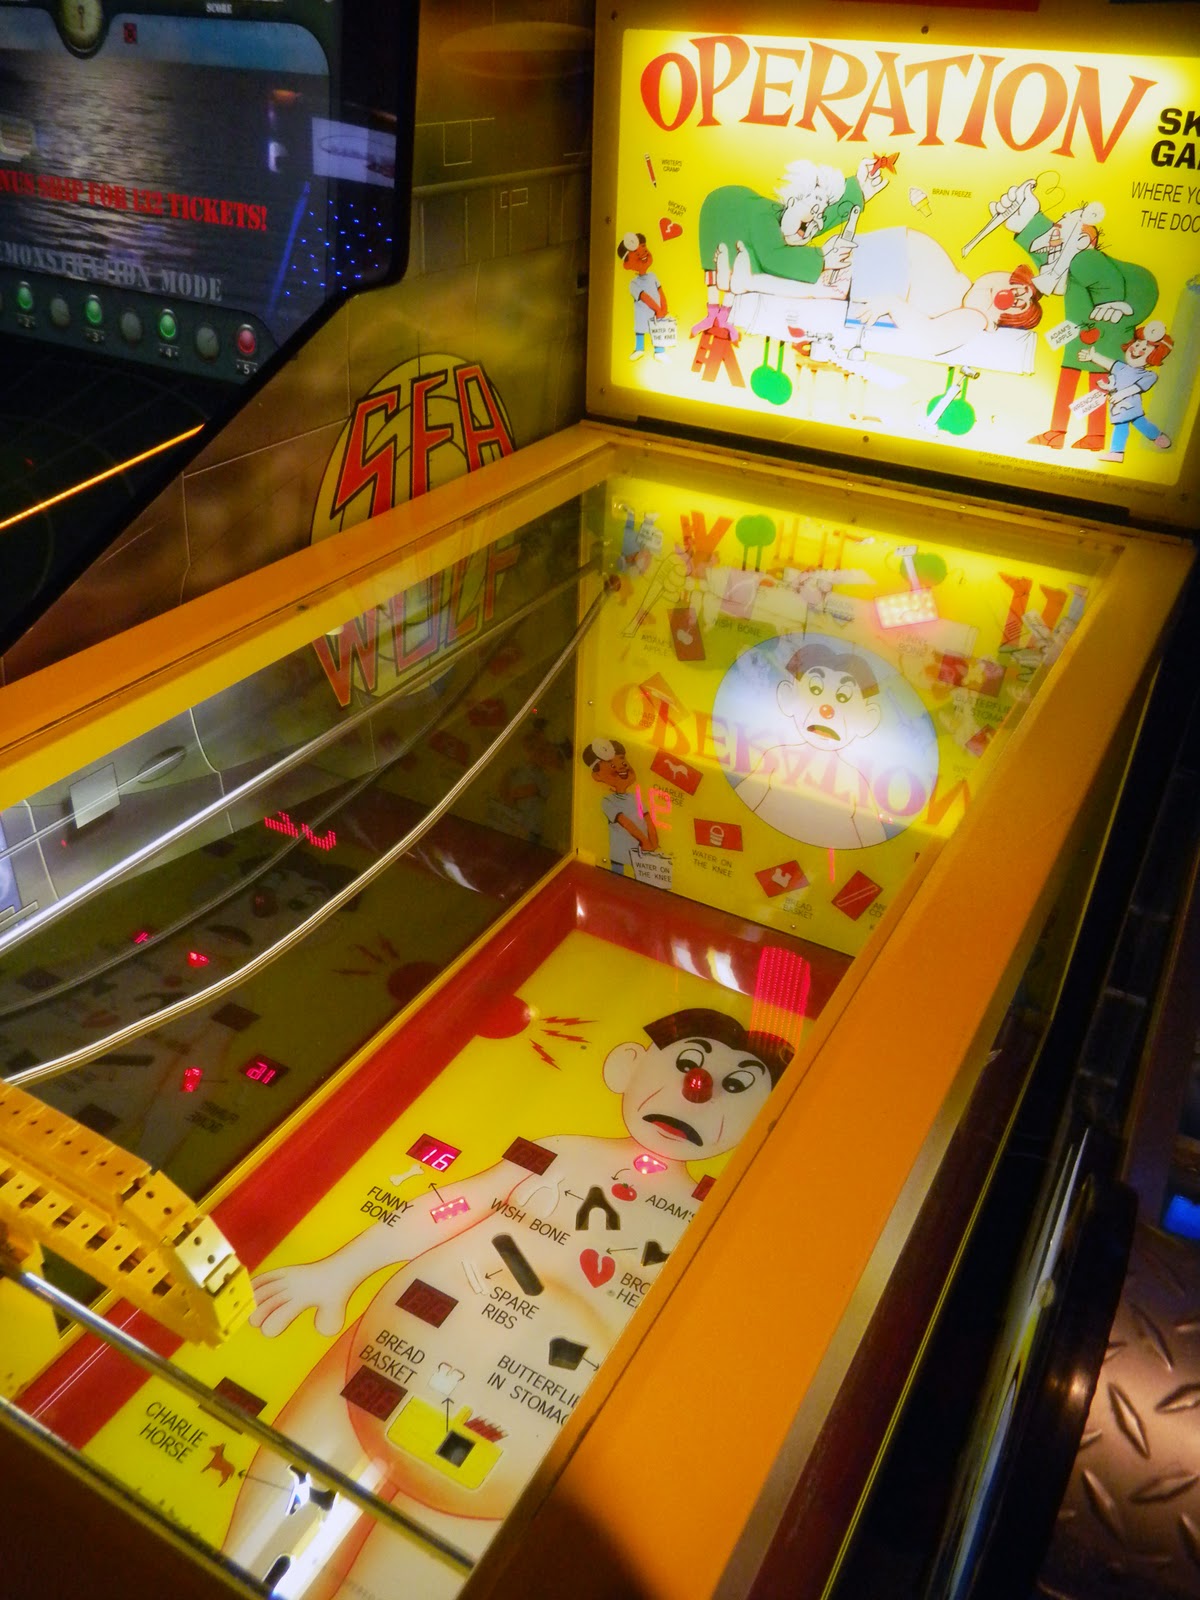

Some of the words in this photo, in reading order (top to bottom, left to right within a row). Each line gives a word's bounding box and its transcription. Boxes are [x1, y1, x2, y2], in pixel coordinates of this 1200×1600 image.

[206, 3, 233, 14] SCORE
[640, 35, 1158, 163] OPERATION
[1150, 139, 1200, 170] GA
[38, 174, 84, 203] SHIP
[88, 182, 127, 209] FOR
[167, 192, 268, 231] TICKETS!
[932, 188, 950, 196] BRAIN
[951, 190, 972, 198] FREEZE
[1131, 181, 1184, 203] WHERE
[667, 200, 687, 213] BROKEN
[667, 207, 684, 216] HEART
[1141, 210, 1168, 230] THE
[161, 268, 223, 302] MODE
[1050, 324, 1072, 341] ADAM'S
[1055, 330, 1073, 345] APPLE
[243, 362, 250, 375] 5
[1082, 399, 1100, 414] ANKLE
[330, 361, 516, 521] SEA
[636, 862, 657, 872] WATER
[660, 866, 670, 874] ON
[692, 849, 718, 864] WATER
[720, 858, 733, 869] ON
[694, 858, 708, 870] THE
[712, 866, 733, 878] KNEE
[639, 870, 651, 878] THE
[655, 874, 672, 883] KNEE
[421, 1148, 456, 1171] 16
[366, 1185, 415, 1214] FUNNY
[360, 1200, 401, 1228] BONE
[490, 1197, 525, 1224] WISH
[528, 1218, 571, 1246] BONE
[488, 1286, 540, 1320] SPARE
[616, 1288, 640, 1309] HE
[481, 1302, 518, 1330] RIBS
[374, 1329, 426, 1366] BREAD
[358, 1344, 418, 1386] BASKET
[487, 1372, 506, 1390] IN
[145, 1401, 208, 1448] CHARLIE
[138, 1422, 193, 1464] HORSE
